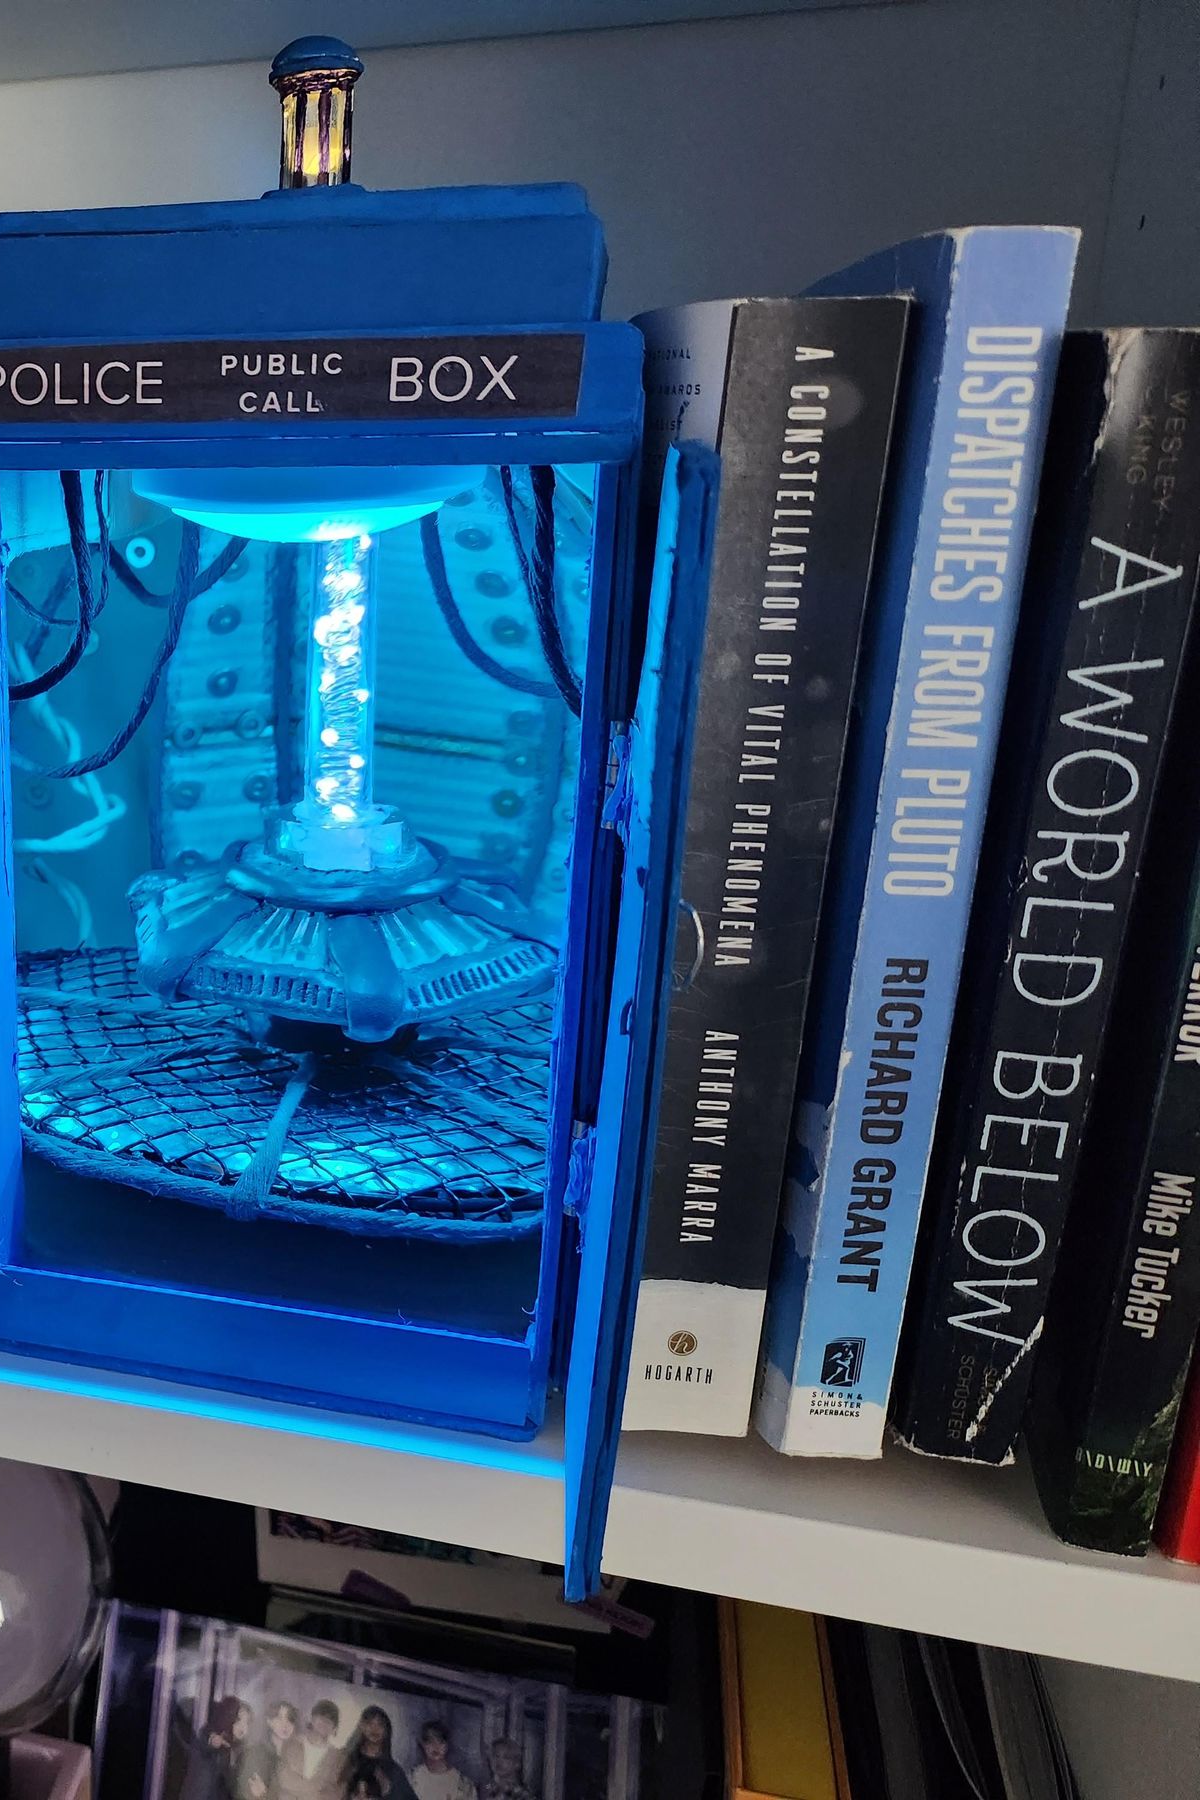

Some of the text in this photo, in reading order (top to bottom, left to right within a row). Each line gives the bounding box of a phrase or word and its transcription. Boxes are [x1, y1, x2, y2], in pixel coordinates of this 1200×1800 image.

[220, 353, 343, 376] PUBLIC
[239, 391, 321, 413] CALL
[389, 355, 519, 403] BOX
[1152, 390, 1189, 511] WESLEY
[883, 326, 1043, 897] DISPATCHES FROM PLUTO
[714, 346, 835, 967] A CONSTELLATION OF VITAL PHENOMENA
[947, 536, 1183, 1346] A WORLD BELOW
[679, 1030, 740, 1243] ANTHONY MARRA
[836, 957, 929, 1293] RICHARD GRANT
[1122, 1171, 1195, 1339] Mike Tucker
[645, 1364, 714, 1385] HOGARTH
[809, 1408, 860, 1418] PAPERBACKS
[810, 1400, 862, 1409] SCHUSTER
[811, 1391, 854, 1400] SIMON
[946, 1354, 975, 1440] SCHUSTER
